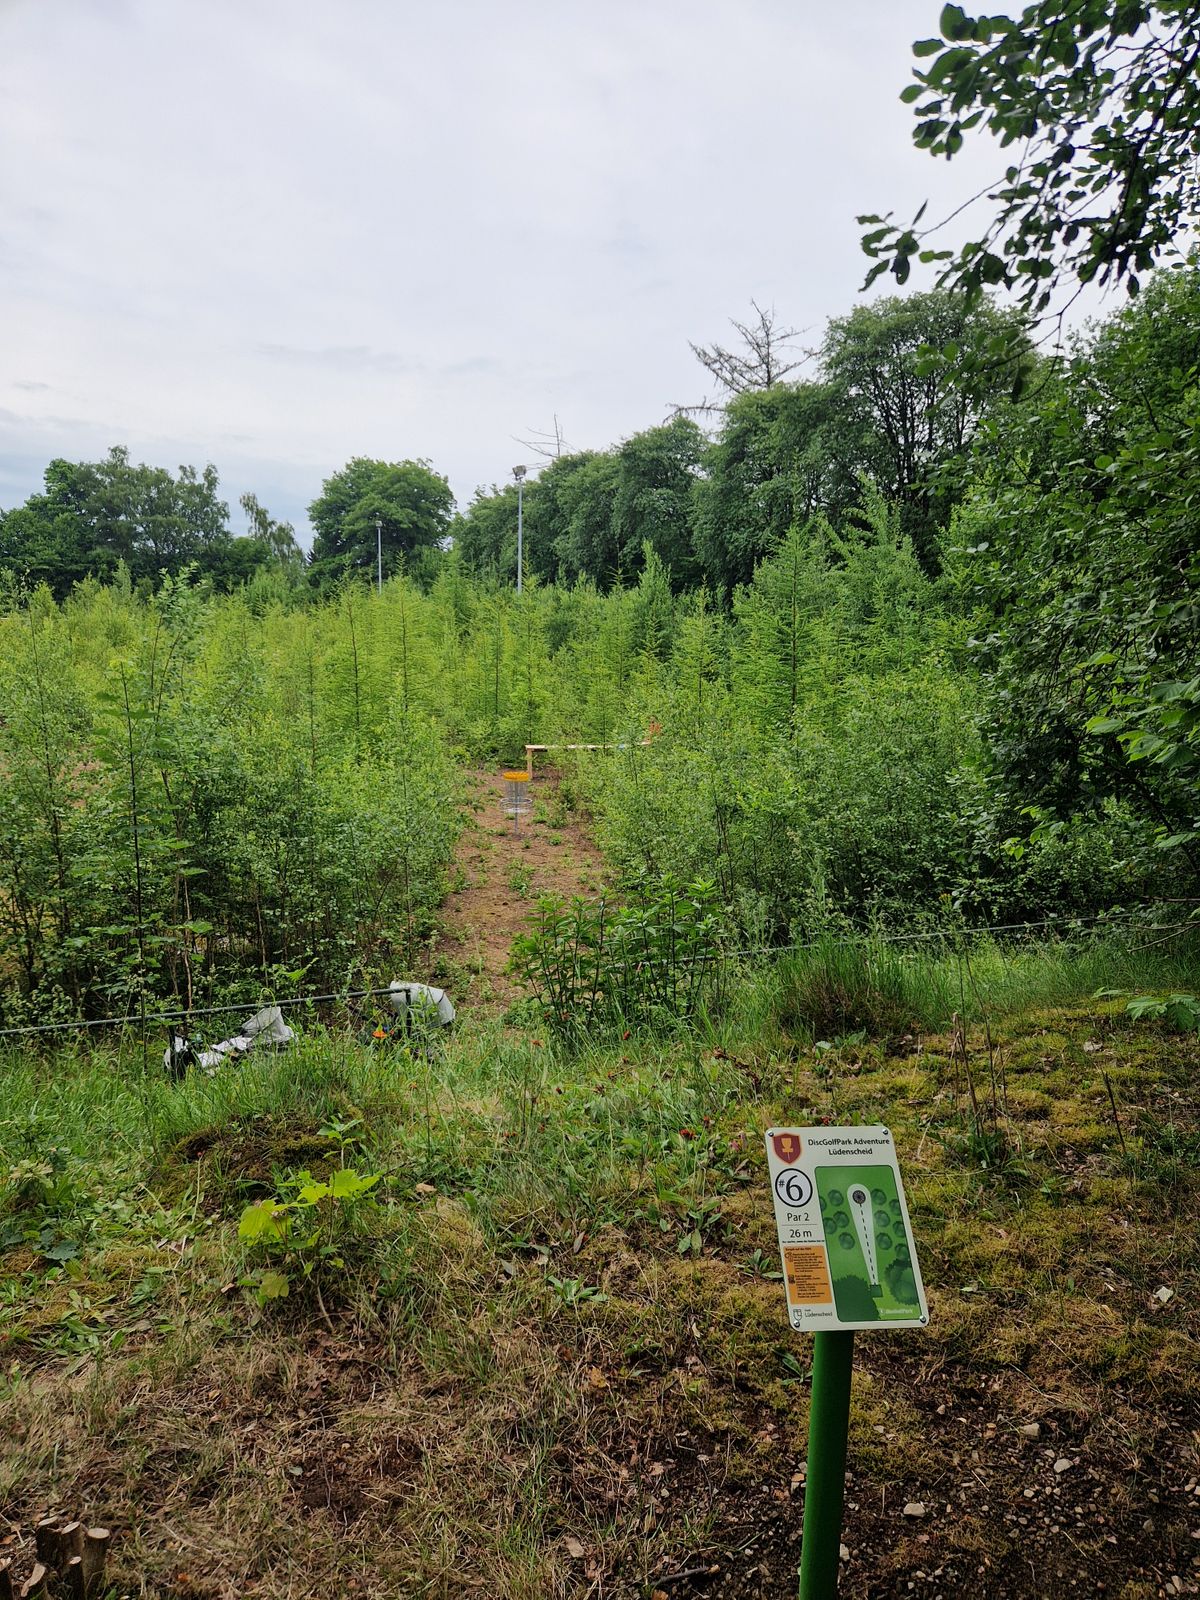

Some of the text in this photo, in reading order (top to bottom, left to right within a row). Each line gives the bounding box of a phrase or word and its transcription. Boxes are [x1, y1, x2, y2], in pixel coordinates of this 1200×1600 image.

[808, 1138, 852, 1146] DiscGolfPark
[828, 1148, 873, 1156] Lüdenscheid
[787, 1212, 810, 1221] Par 2
[789, 1229, 812, 1238] 26 m
